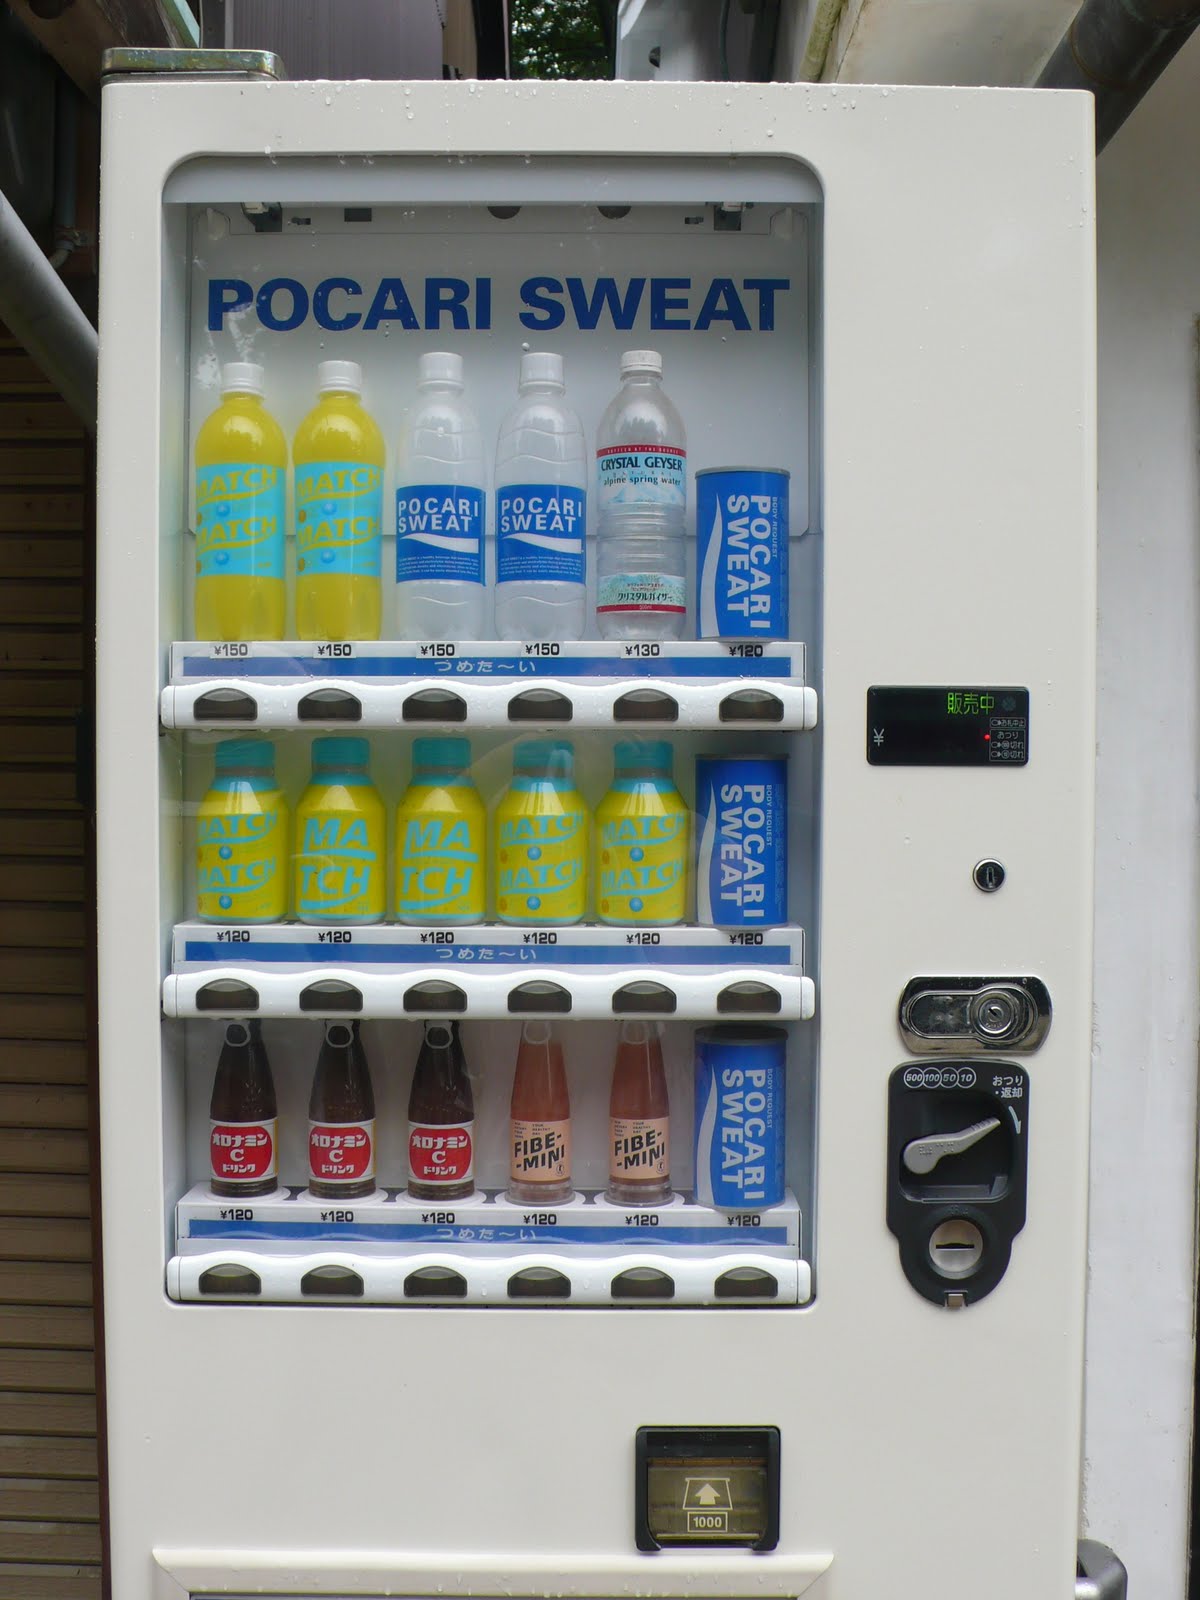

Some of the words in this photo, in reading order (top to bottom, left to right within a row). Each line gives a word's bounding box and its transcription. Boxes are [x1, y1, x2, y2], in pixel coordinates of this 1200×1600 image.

[208, 277, 490, 331] POCARI
[518, 277, 790, 331] SWEAT
[601, 456, 640, 471] CRYSTAL
[644, 456, 683, 472] GEYSER
[604, 476, 626, 487] alpine
[630, 475, 658, 486] spring
[661, 477, 681, 486] water
[398, 497, 479, 517] POCARI
[501, 497, 582, 517] POCARI
[398, 514, 473, 533] SWEAT
[501, 514, 576, 533] SWEAT
[727, 495, 750, 617] SWEAT
[750, 495, 771, 629] POCARI
[214, 643, 248, 656] ¥150
[317, 643, 351, 656] ¥150
[420, 644, 455, 656] ¥150
[525, 643, 559, 655] ¥150
[625, 644, 660, 657] ¥130
[729, 645, 763, 657] ¥120
[947, 692, 995, 715] 販売中
[873, 728, 885, 746] ¥
[303, 818, 369, 850] MA
[404, 821, 470, 851] MA
[721, 784, 743, 907] SWEAT
[743, 784, 765, 917] POCARI
[300, 866, 371, 896] TCH
[401, 867, 473, 896] TCH
[217, 930, 250, 942] ¥120
[318, 931, 351, 943] ¥120
[420, 932, 454, 944] ¥120
[523, 933, 557, 944] ¥120
[626, 933, 660, 945] ¥120
[730, 933, 763, 945] ¥120
[905, 1074, 923, 1082] 500
[924, 1074, 940, 1082] 100
[942, 1074, 956, 1082] 50
[960, 1074, 972, 1082] 10
[992, 1075, 1023, 1086] おつり
[721, 1068, 744, 1189] SWEAT
[743, 1069, 766, 1200] POCARI
[213, 1133, 268, 1148] オロナミン
[311, 1134, 367, 1149] オロナミン
[412, 1135, 469, 1149] オロナミン
[514, 1131, 562, 1158] FIBE-
[614, 1129, 662, 1156] FIBE-
[230, 1149, 245, 1162] C
[328, 1149, 344, 1163] C
[431, 1151, 447, 1164] C
[516, 1144, 565, 1171] -MINI
[616, 1141, 665, 1170] -MINI
[222, 1163, 256, 1174] ドリンク
[321, 1164, 355, 1174] ドリンク
[423, 1165, 457, 1175] ドリンク
[220, 1209, 253, 1221] ¥120
[320, 1211, 354, 1223] ¥120
[421, 1212, 455, 1224] ¥120
[523, 1214, 557, 1225] ¥120
[625, 1215, 659, 1226] ¥120
[727, 1215, 761, 1227] ¥120
[693, 1516, 722, 1528] 1000
